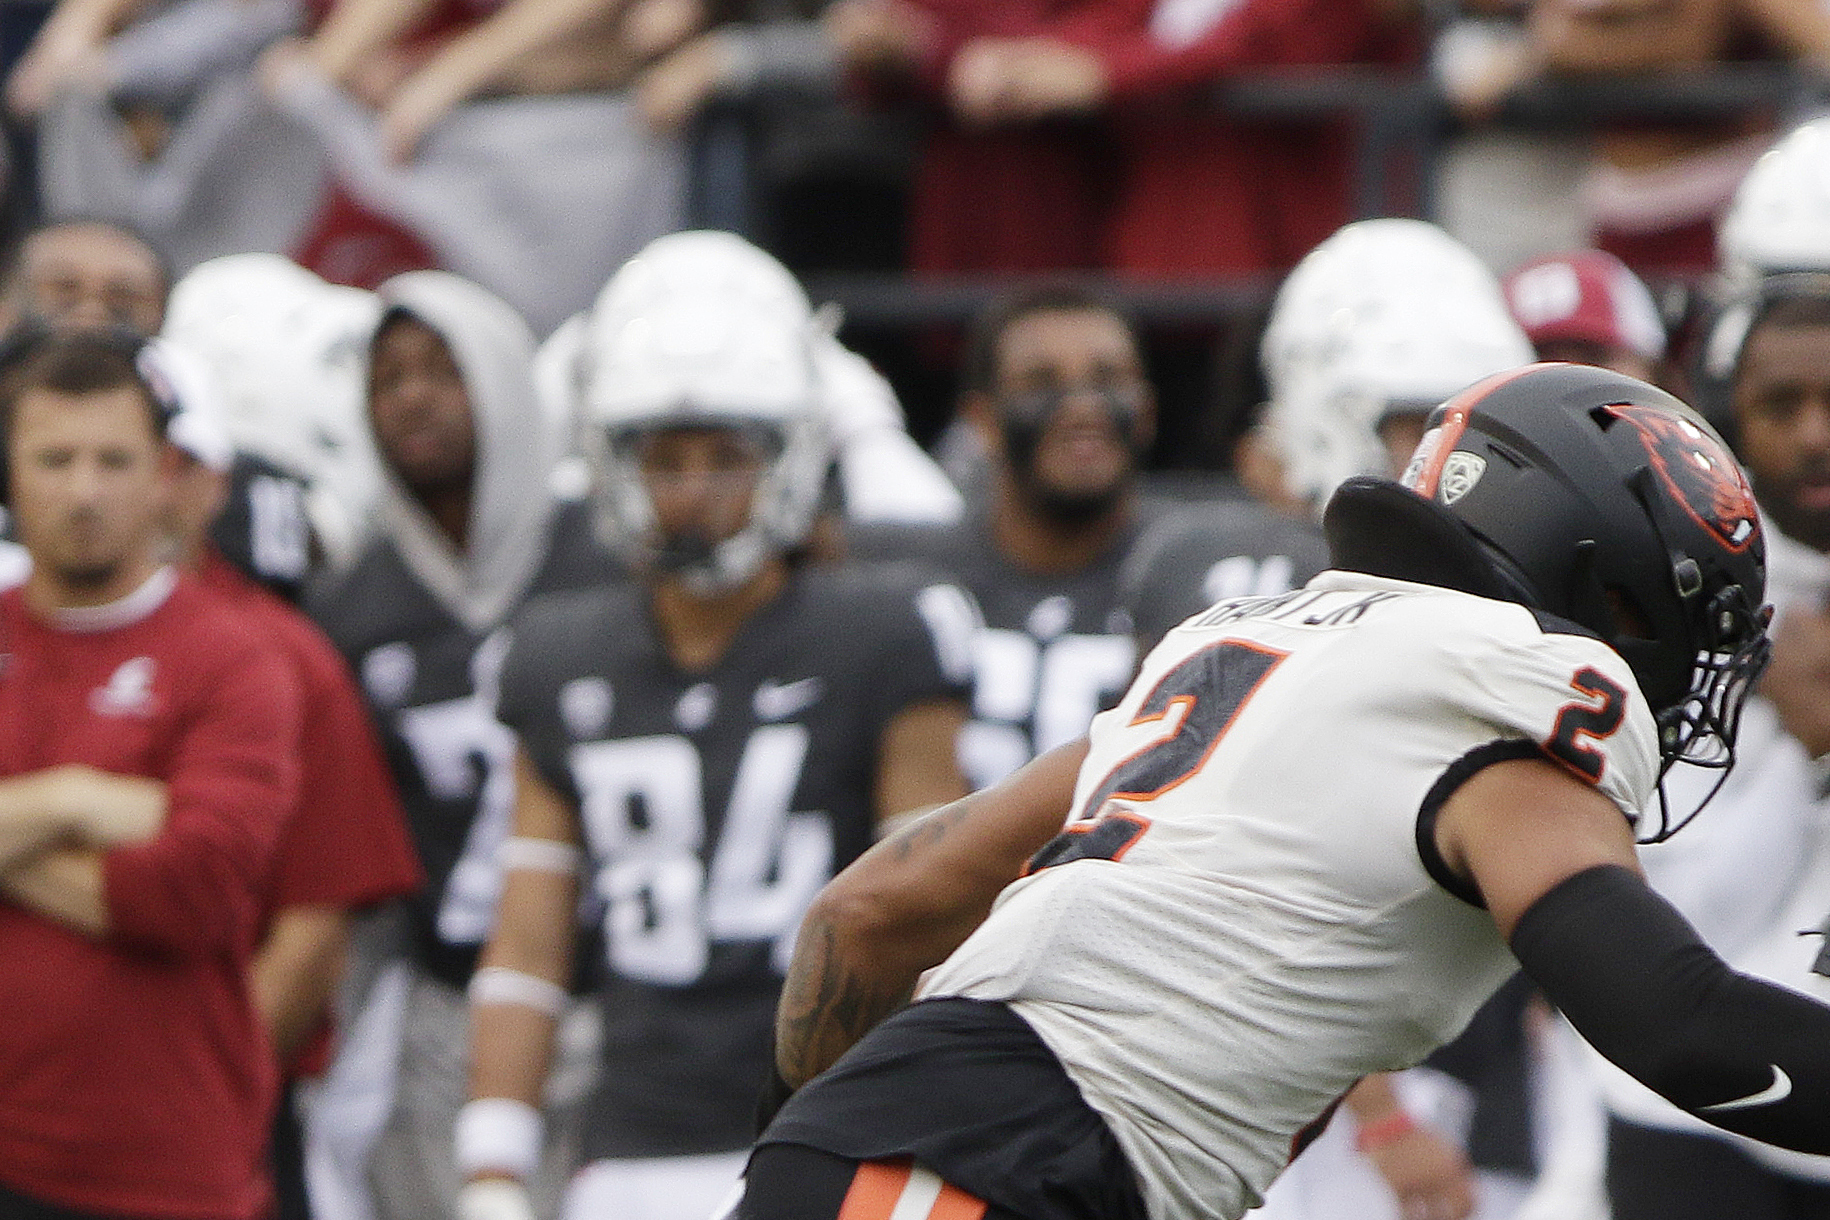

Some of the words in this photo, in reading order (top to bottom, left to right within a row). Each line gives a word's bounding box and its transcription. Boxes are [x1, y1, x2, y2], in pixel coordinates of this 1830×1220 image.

[1018, 637, 1290, 878] 2
[1539, 665, 1628, 786] 2
[568, 718, 838, 986] 84
